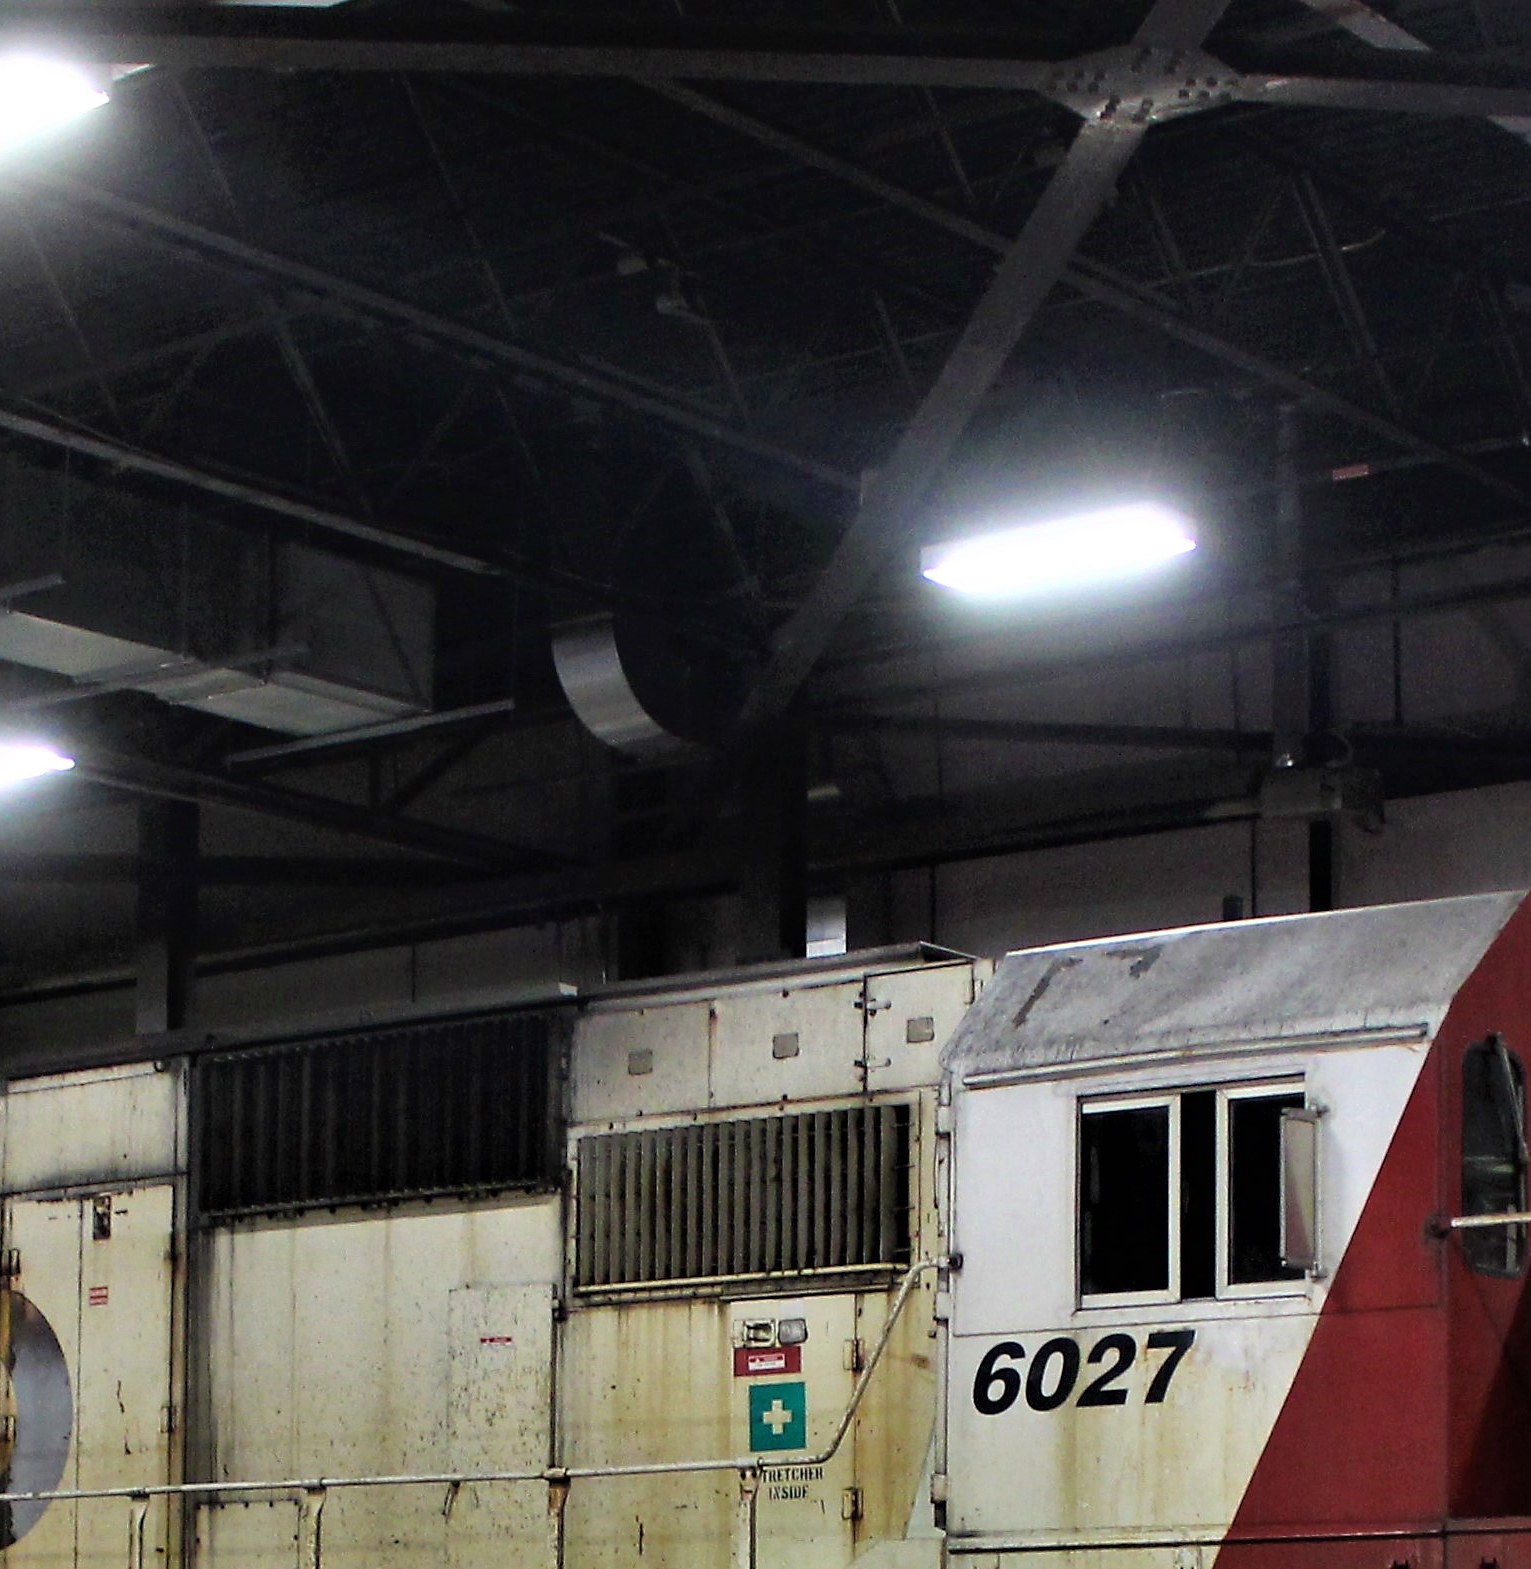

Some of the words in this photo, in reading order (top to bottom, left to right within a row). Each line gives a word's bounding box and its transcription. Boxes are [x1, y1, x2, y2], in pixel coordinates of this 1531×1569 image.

[972, 1329, 1196, 1415] 6027
[760, 1466, 824, 1483] TRETCHER
[769, 1485, 808, 1500] INSIDE
